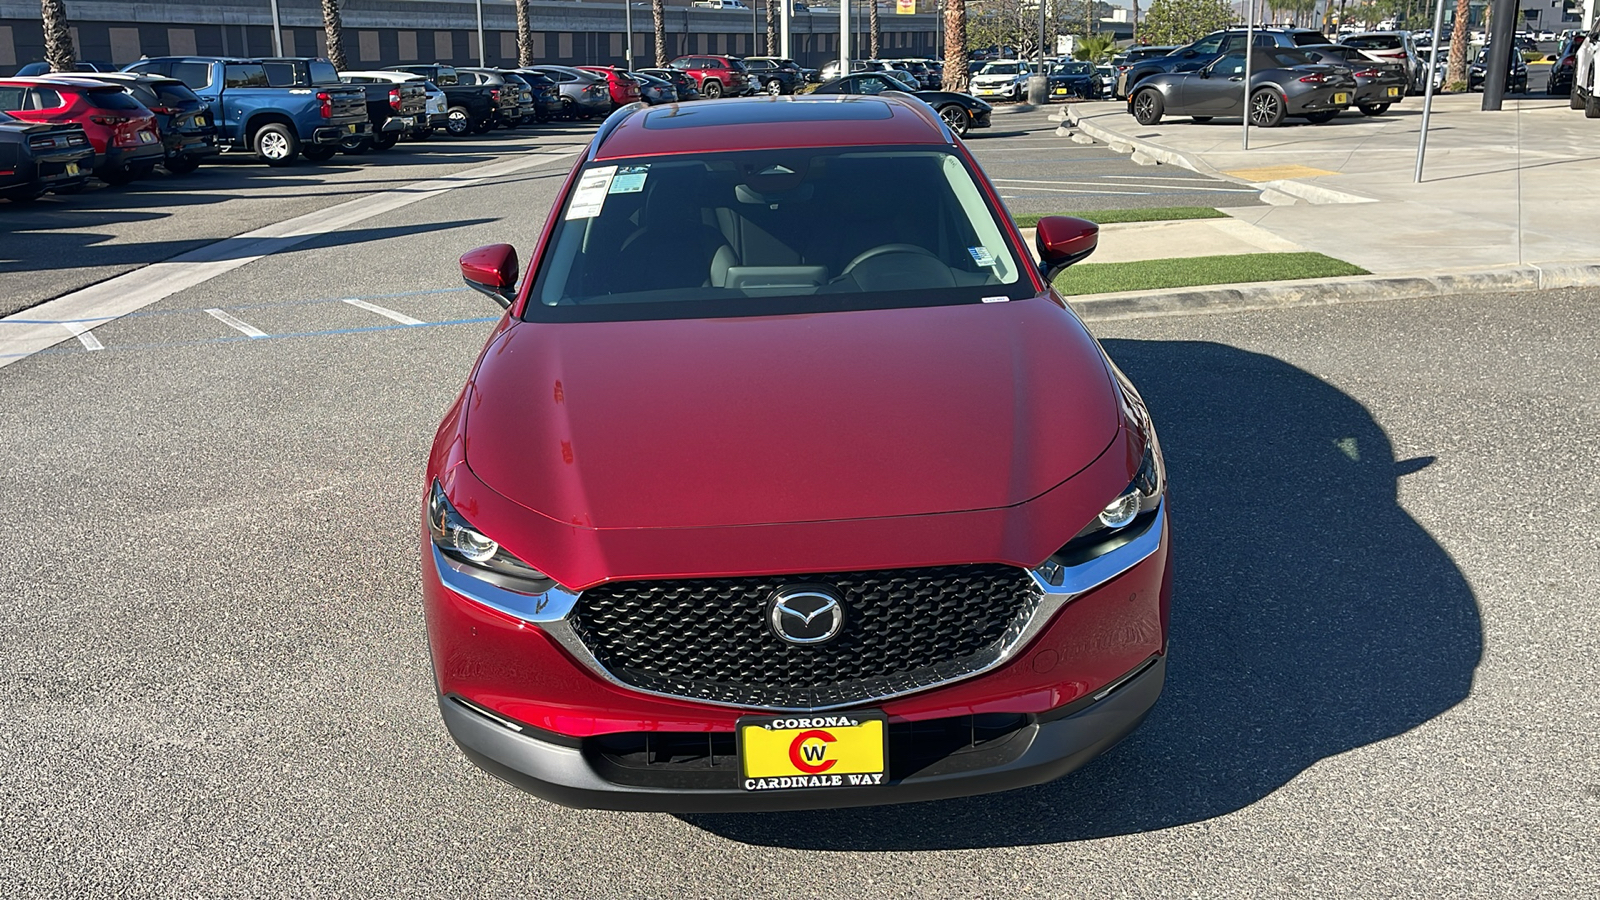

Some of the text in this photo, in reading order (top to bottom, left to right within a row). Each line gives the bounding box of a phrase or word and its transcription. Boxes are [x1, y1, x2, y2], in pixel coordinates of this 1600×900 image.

[772, 716, 850, 729] CORONA
[789, 729, 838, 774] C
[803, 744, 827, 761] W
[745, 773, 884, 790] CARDINALE WAY
